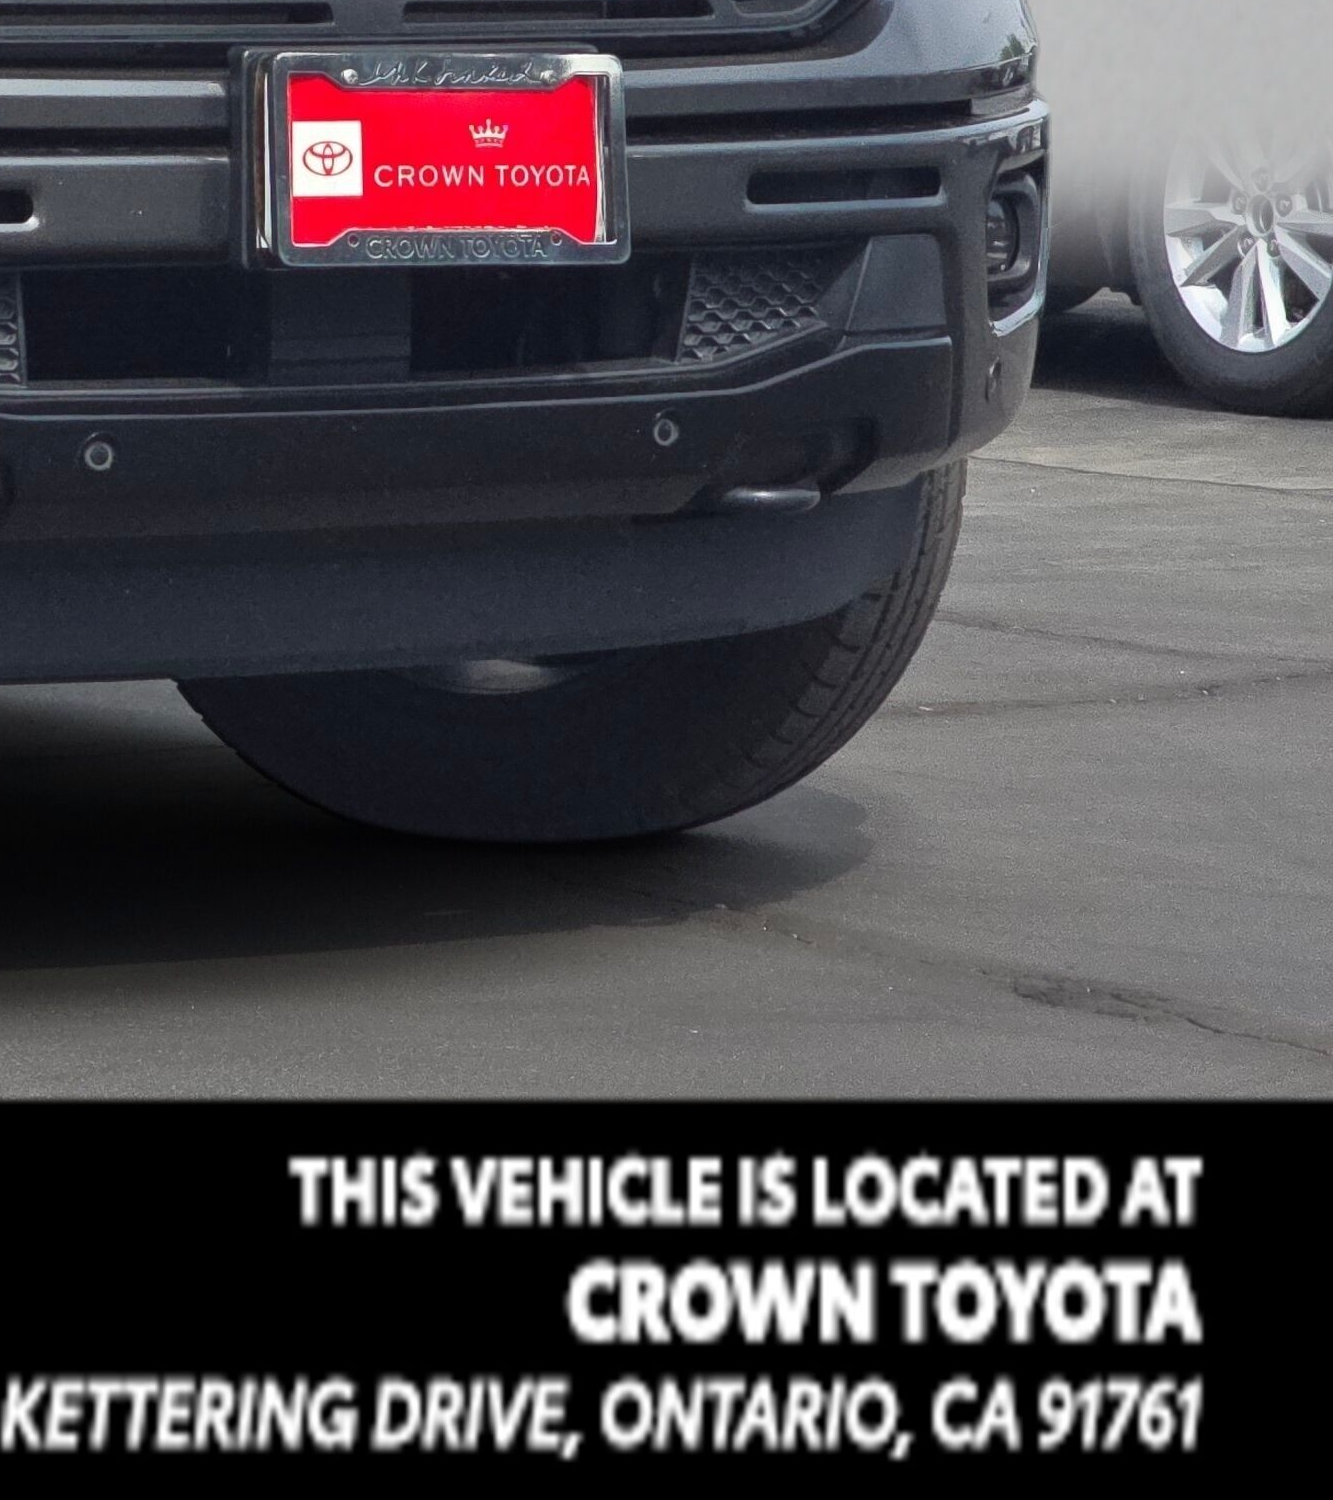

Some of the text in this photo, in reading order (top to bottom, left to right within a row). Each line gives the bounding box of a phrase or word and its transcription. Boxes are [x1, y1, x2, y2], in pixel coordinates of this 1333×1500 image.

[373, 164, 590, 188] CROWN TOYOTA
[365, 234, 549, 261] CROWN TOYOTA
